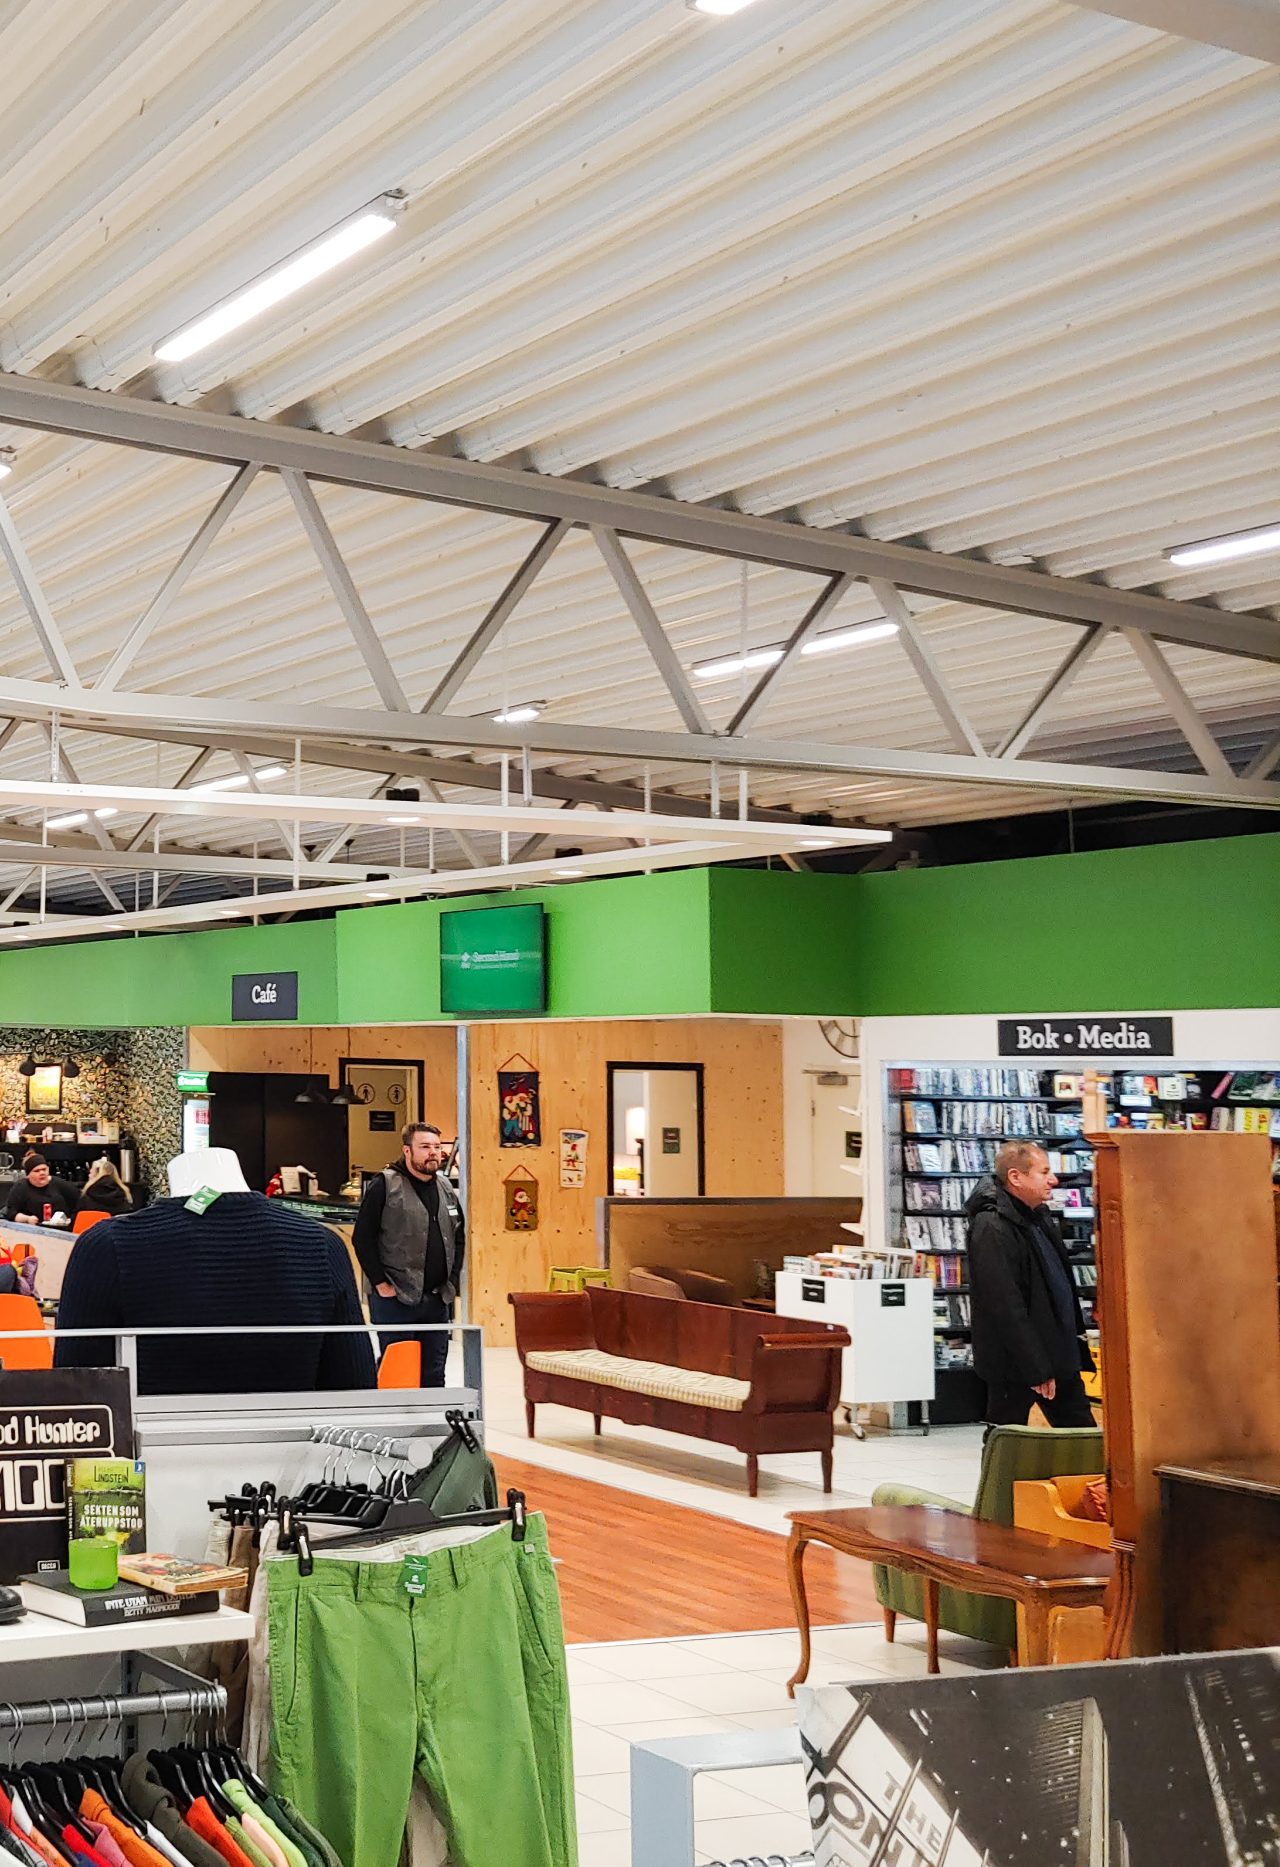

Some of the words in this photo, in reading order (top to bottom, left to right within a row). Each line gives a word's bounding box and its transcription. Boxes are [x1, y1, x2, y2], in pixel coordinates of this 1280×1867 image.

[251, 983, 277, 1004] Café
[1016, 1023, 1060, 1049] Bok
[1077, 1022, 1152, 1049] Media
[24, 1415, 100, 1444] Hunter
[84, 1504, 118, 1516] SEKTEN
[119, 1506, 139, 1517] SOM
[80, 1515, 143, 1528] ÅTERUPPSTOD
[126, 1596, 148, 1607] UTAN
[883, 1770, 943, 1854] THE
